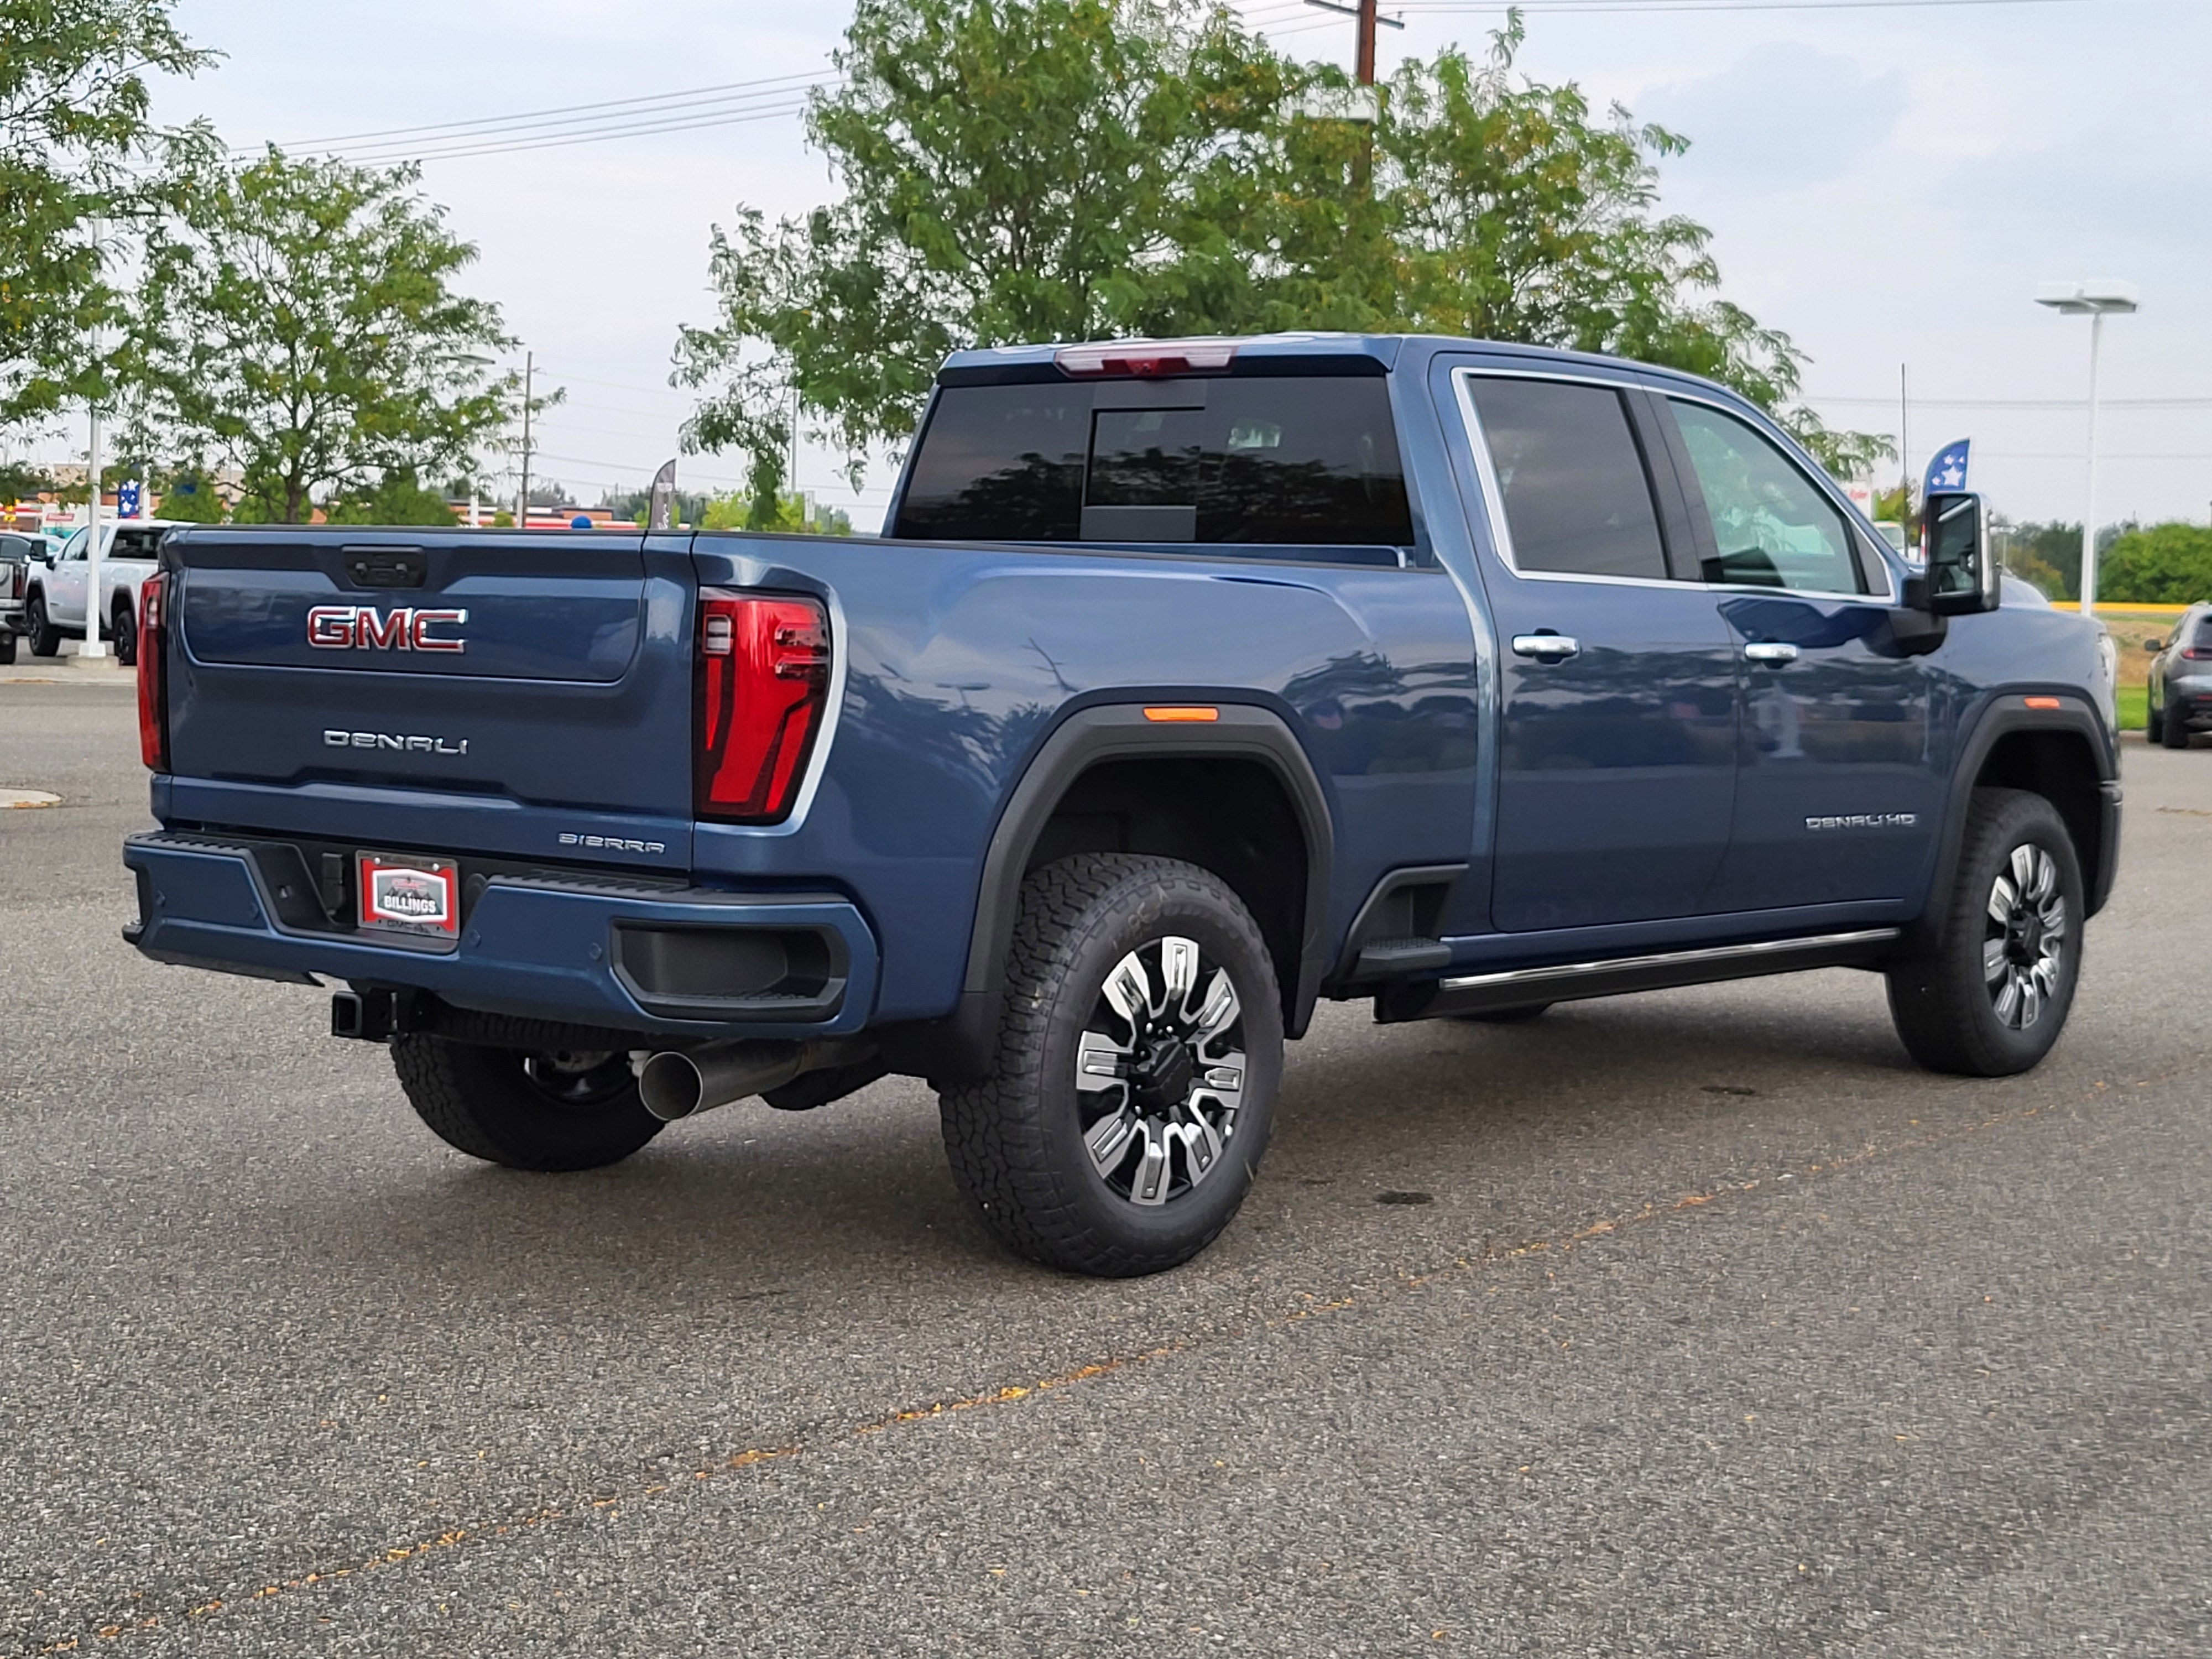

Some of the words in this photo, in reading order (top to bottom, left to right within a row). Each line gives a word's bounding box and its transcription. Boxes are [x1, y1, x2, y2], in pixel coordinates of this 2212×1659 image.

[307, 606, 468, 654] GMC
[324, 730, 468, 754] DENALI
[1806, 815, 1883, 830] DENALI
[1885, 813, 1917, 826] HD
[558, 833, 665, 854] SIERRA
[384, 895, 436, 914] BILLINGS
